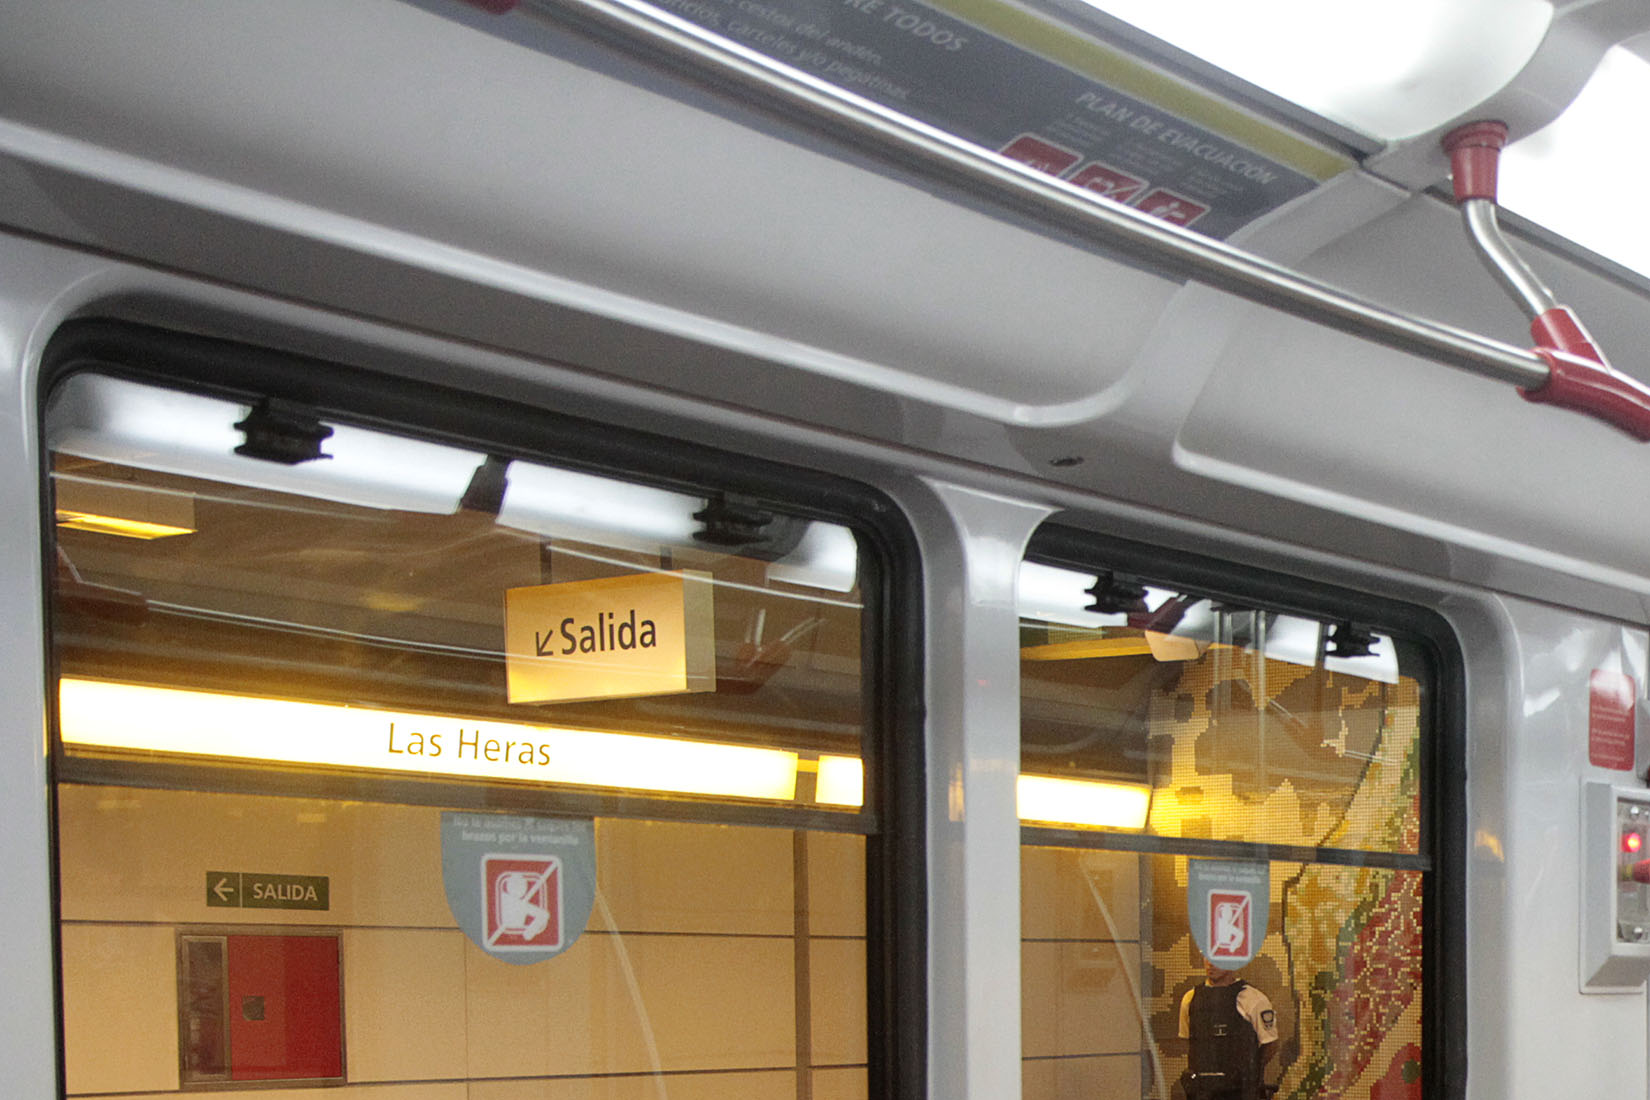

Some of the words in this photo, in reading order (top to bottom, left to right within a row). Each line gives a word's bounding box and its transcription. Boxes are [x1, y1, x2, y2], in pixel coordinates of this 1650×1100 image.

[727, 20, 797, 53] carteles
[883, 6, 968, 50] TODOS
[1076, 92, 1134, 123] PLAN
[1130, 114, 1163, 136] DE
[559, 609, 657, 656] Salida
[388, 723, 442, 757] Las
[458, 729, 551, 767] Heras
[253, 882, 318, 901] SALIDA
